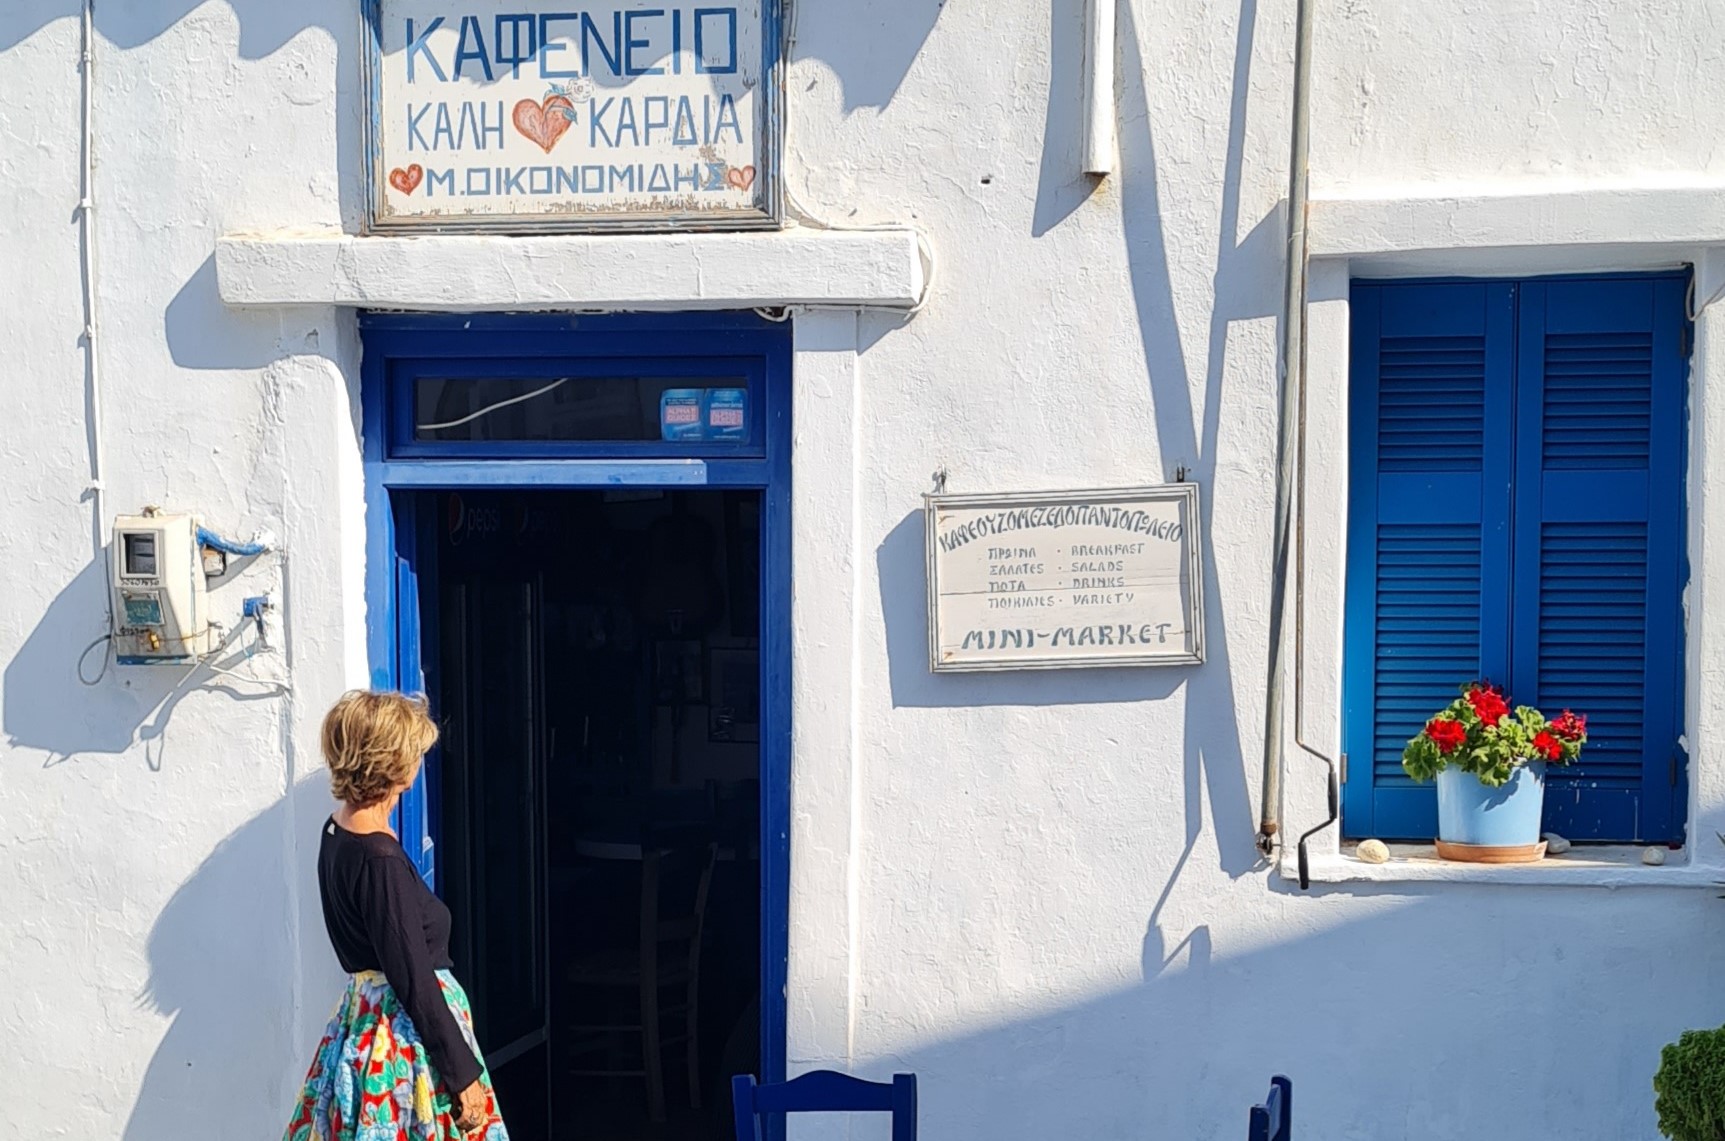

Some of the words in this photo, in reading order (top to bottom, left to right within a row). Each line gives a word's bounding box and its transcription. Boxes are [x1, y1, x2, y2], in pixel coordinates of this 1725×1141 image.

[406, 8, 738, 83] ΚΑΦΕΝΕΙΟ
[407, 101, 504, 151] ΚΑΛΗ
[589, 94, 743, 148] ΚΑΡΔΙΑ
[1071, 543, 1145, 556] BREAKFAST
[1071, 560, 1124, 573] SALADS
[1073, 577, 1125, 589] DRINKS
[1073, 593, 1135, 606] VARIETY
[961, 622, 1172, 650] MINI-MARKET
